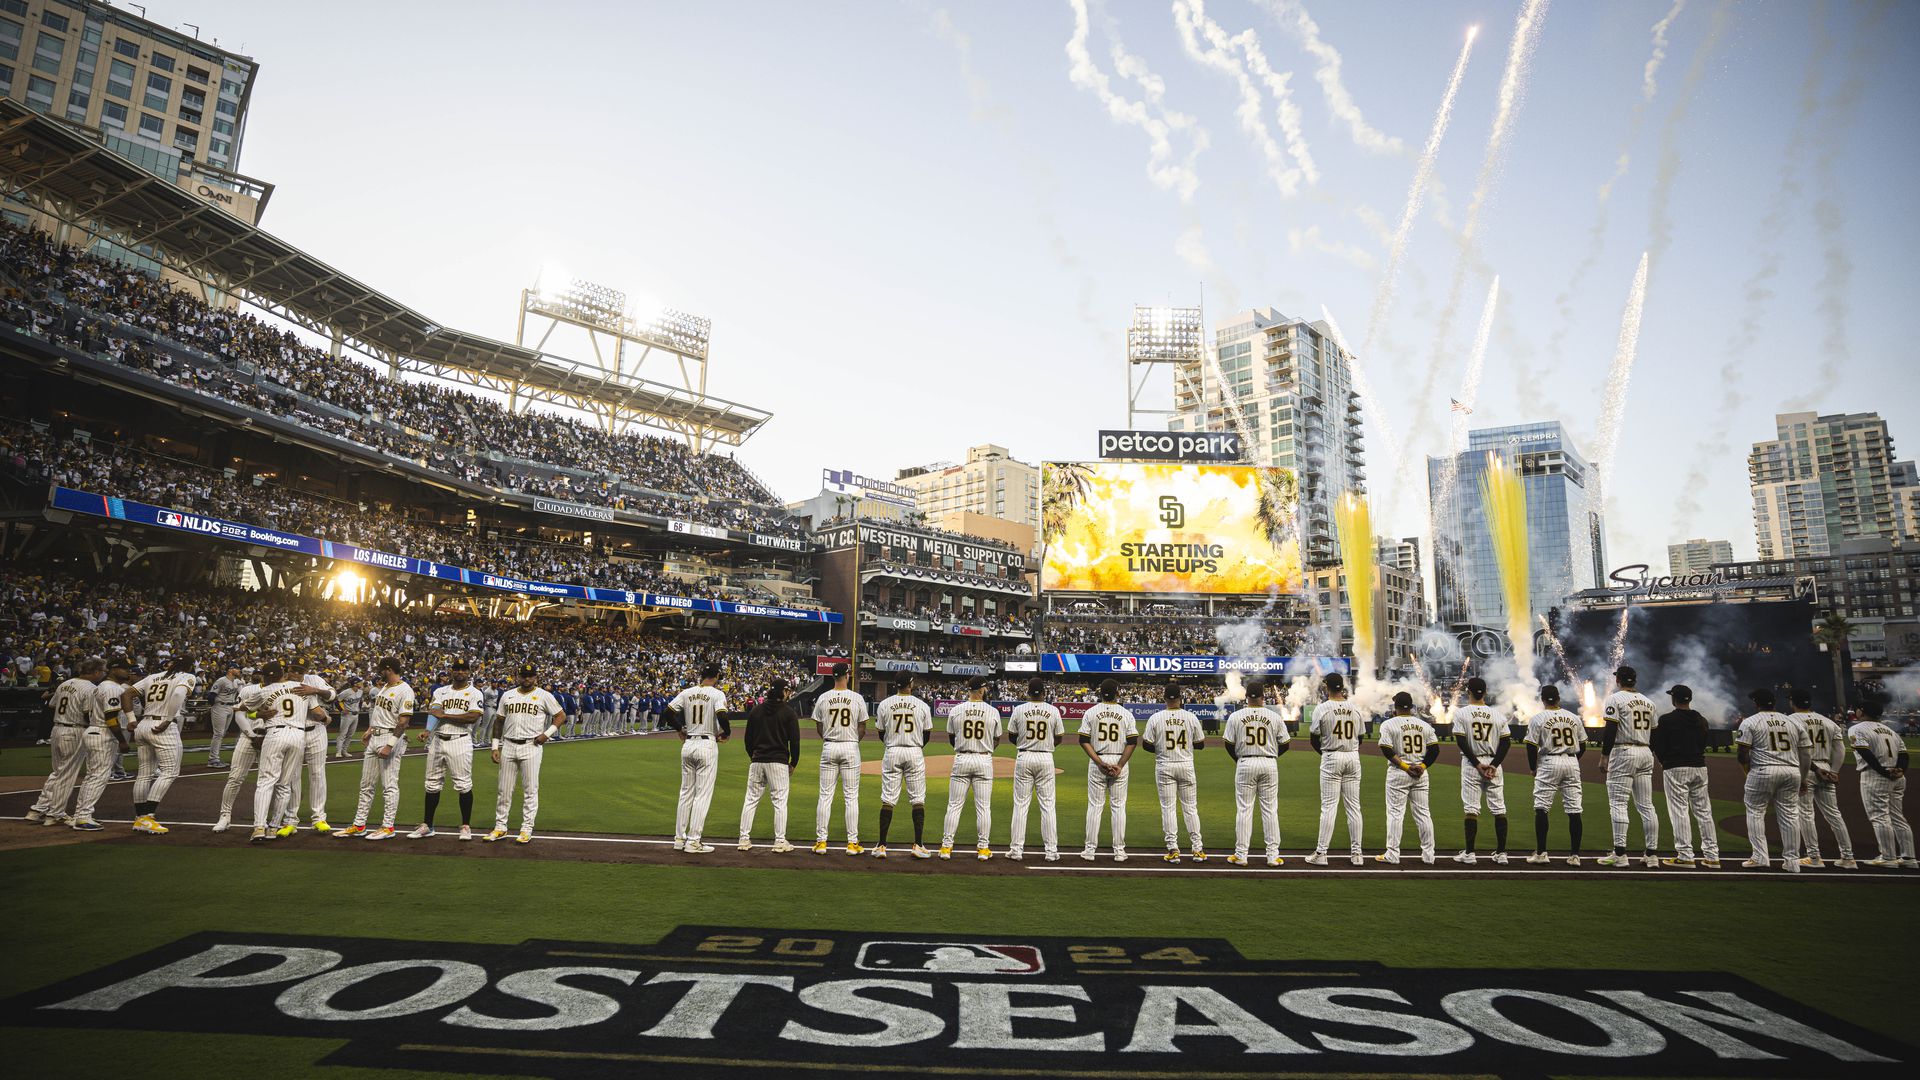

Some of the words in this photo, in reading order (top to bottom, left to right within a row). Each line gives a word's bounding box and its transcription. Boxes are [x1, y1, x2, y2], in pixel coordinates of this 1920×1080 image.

[198, 185, 233, 204] OMNI
[1101, 432, 1174, 457] petco
[1178, 435, 1236, 458] park
[1521, 432, 1558, 442] SEMPRA
[536, 501, 573, 514] CIUDAD
[574, 507, 613, 520] MADERAS
[183, 515, 221, 534] NLDS
[222, 525, 247, 537] 2024
[250, 529, 299, 547] Booking.com
[817, 532, 837, 549] PLY
[839, 529, 857, 546] CO.
[755, 534, 800, 551] CUTWATER
[859, 526, 918, 550] WESTERN
[923, 538, 961, 558] METAL
[963, 546, 1004, 564] SUPPLY
[1007, 554, 1024, 568] CO.
[1120, 543, 1224, 558] STARTING
[353, 548, 371, 562] LOS
[371, 552, 408, 569] ANGELES
[1128, 558, 1218, 573] LINEUPS
[495, 577, 514, 589] NLDS
[529, 583, 568, 594] Booking.com
[1608, 564, 1730, 598] Sycuan
[655, 596, 669, 606] SAN
[671, 597, 693, 608] DIEGO
[747, 605, 767, 615] NLDS
[780, 609, 808, 618] Booking.com
[893, 619, 917, 630] ORIS
[1139, 657, 1183, 672] NLDS
[1183, 661, 1214, 669] 2024
[1218, 659, 1284, 671] Booking.com
[147, 683, 169, 702] 23
[829, 696, 852, 706] HOEING
[58, 696, 69, 715] 8
[282, 698, 294, 718] 9
[442, 698, 470, 712] ADRES
[692, 704, 704, 724] 11
[965, 709, 985, 718] SCOTT
[1024, 709, 1052, 719] PERALTA
[1333, 709, 1352, 717] ADAM
[829, 708, 851, 728] 78
[893, 714, 914, 733] 75
[1096, 711, 1123, 722] ESTRADA
[1471, 711, 1491, 720] JACOB
[1543, 716, 1578, 730] LOCKRIDGE
[1633, 711, 1651, 730] 25
[963, 720, 985, 739] 66
[1026, 720, 1048, 740] 58
[1098, 722, 1119, 742] 56
[1246, 726, 1267, 746] 50
[1333, 720, 1354, 740] 40
[1401, 724, 1424, 733] SOLANO
[1472, 722, 1493, 742] 37
[1551, 727, 1574, 747] 28
[1165, 730, 1187, 750] 54
[1403, 735, 1423, 754] 39
[1769, 731, 1791, 751] 15
[1808, 728, 1827, 749] 14
[1884, 738, 1893, 758] 1
[695, 935, 834, 957] 20
[1066, 944, 1209, 965] 24
[35, 943, 1904, 1063] POSTSEASON
